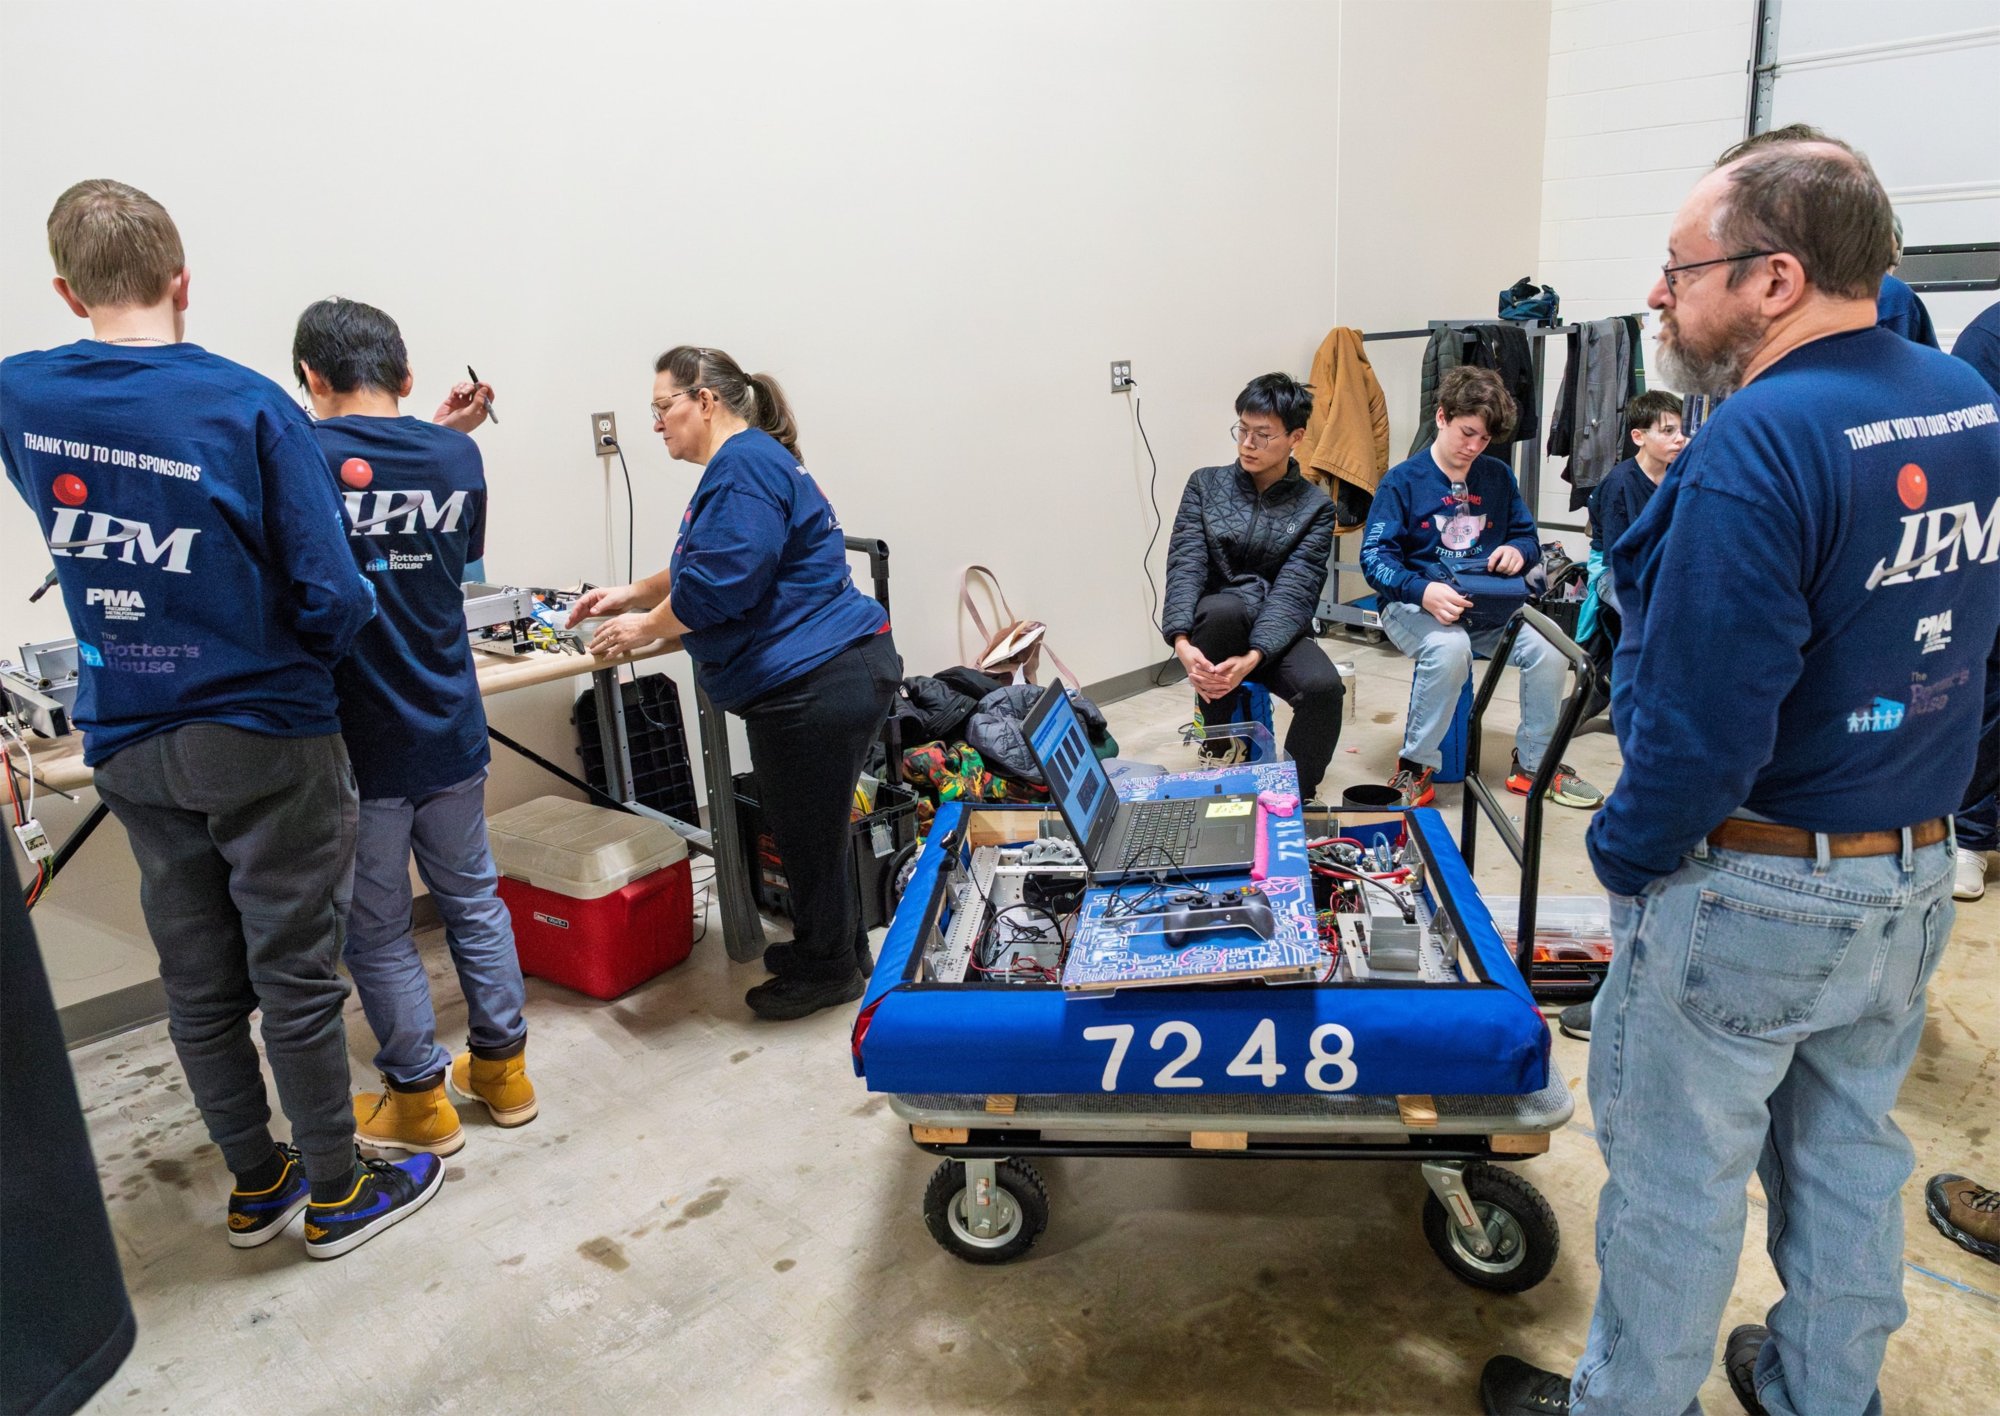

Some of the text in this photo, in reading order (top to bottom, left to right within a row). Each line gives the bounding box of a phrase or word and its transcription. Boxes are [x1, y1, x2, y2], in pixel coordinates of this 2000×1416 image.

[1843, 419, 1896, 450] THANK
[1890, 416, 1918, 440] YOU
[1913, 416, 1930, 438] TO
[1925, 413, 1952, 437] OUR
[23, 432, 201, 482] THANK YOU TO OUR SPONSORS
[341, 489, 469, 537] IPM
[48, 506, 202, 575] IPM
[389, 553, 433, 562] Potter's
[1435, 544, 1483, 559] THE BAON
[389, 561, 423, 570] House
[86, 588, 146, 609] PMA
[101, 631, 118, 641] The
[102, 640, 200, 658] Potter's
[106, 657, 176, 674] House
[1083, 1018, 1358, 1091] 7248
